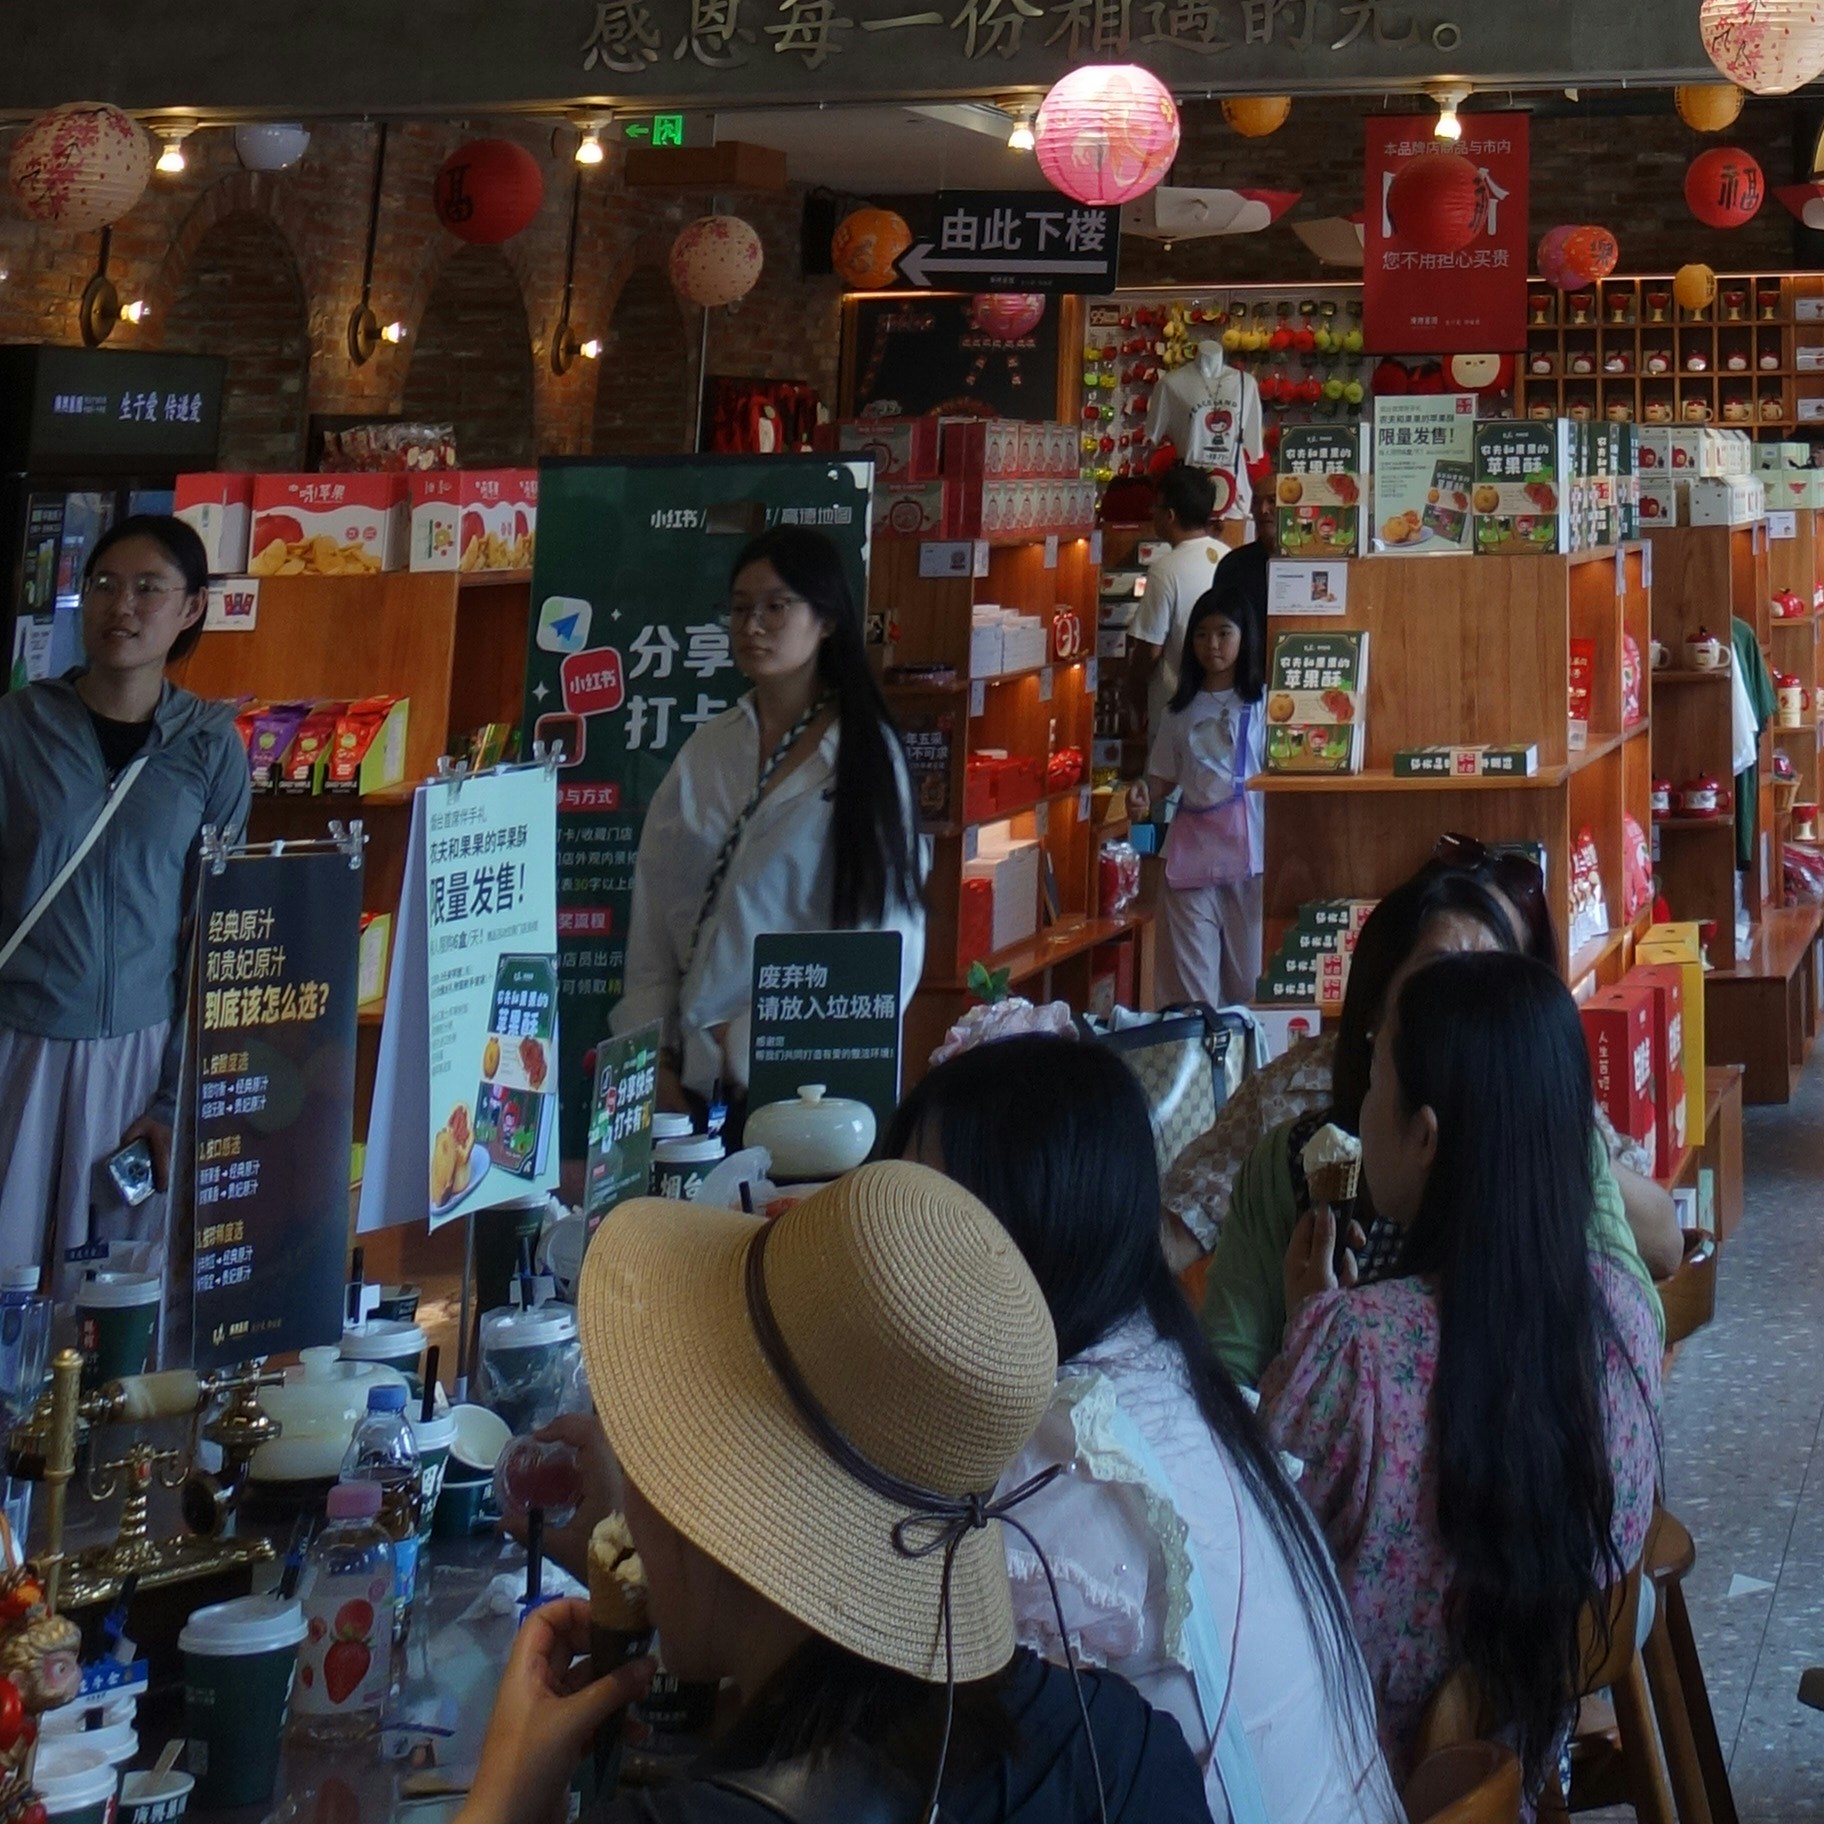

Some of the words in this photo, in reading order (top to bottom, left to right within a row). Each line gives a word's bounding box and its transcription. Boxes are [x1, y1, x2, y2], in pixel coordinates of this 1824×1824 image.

[940, 207, 1107, 252] 由此下楼
[1382, 249, 1510, 271] 您不用担心买贵
[118, 391, 158, 422] 生于爱
[1379, 427, 1454, 446] 限量发售!
[570, 669, 617, 695] 小红书
[1284, 669, 1342, 689] 苹果酥
[430, 861, 526, 928] 限量发售!
[207, 907, 275, 944] 经典原汁
[206, 945, 287, 983] 和贵妃原汁
[758, 963, 828, 989] 废弃物
[204, 980, 331, 1031] 到底该怎么选?
[756, 994, 896, 1021] 请放入垃圾桶
